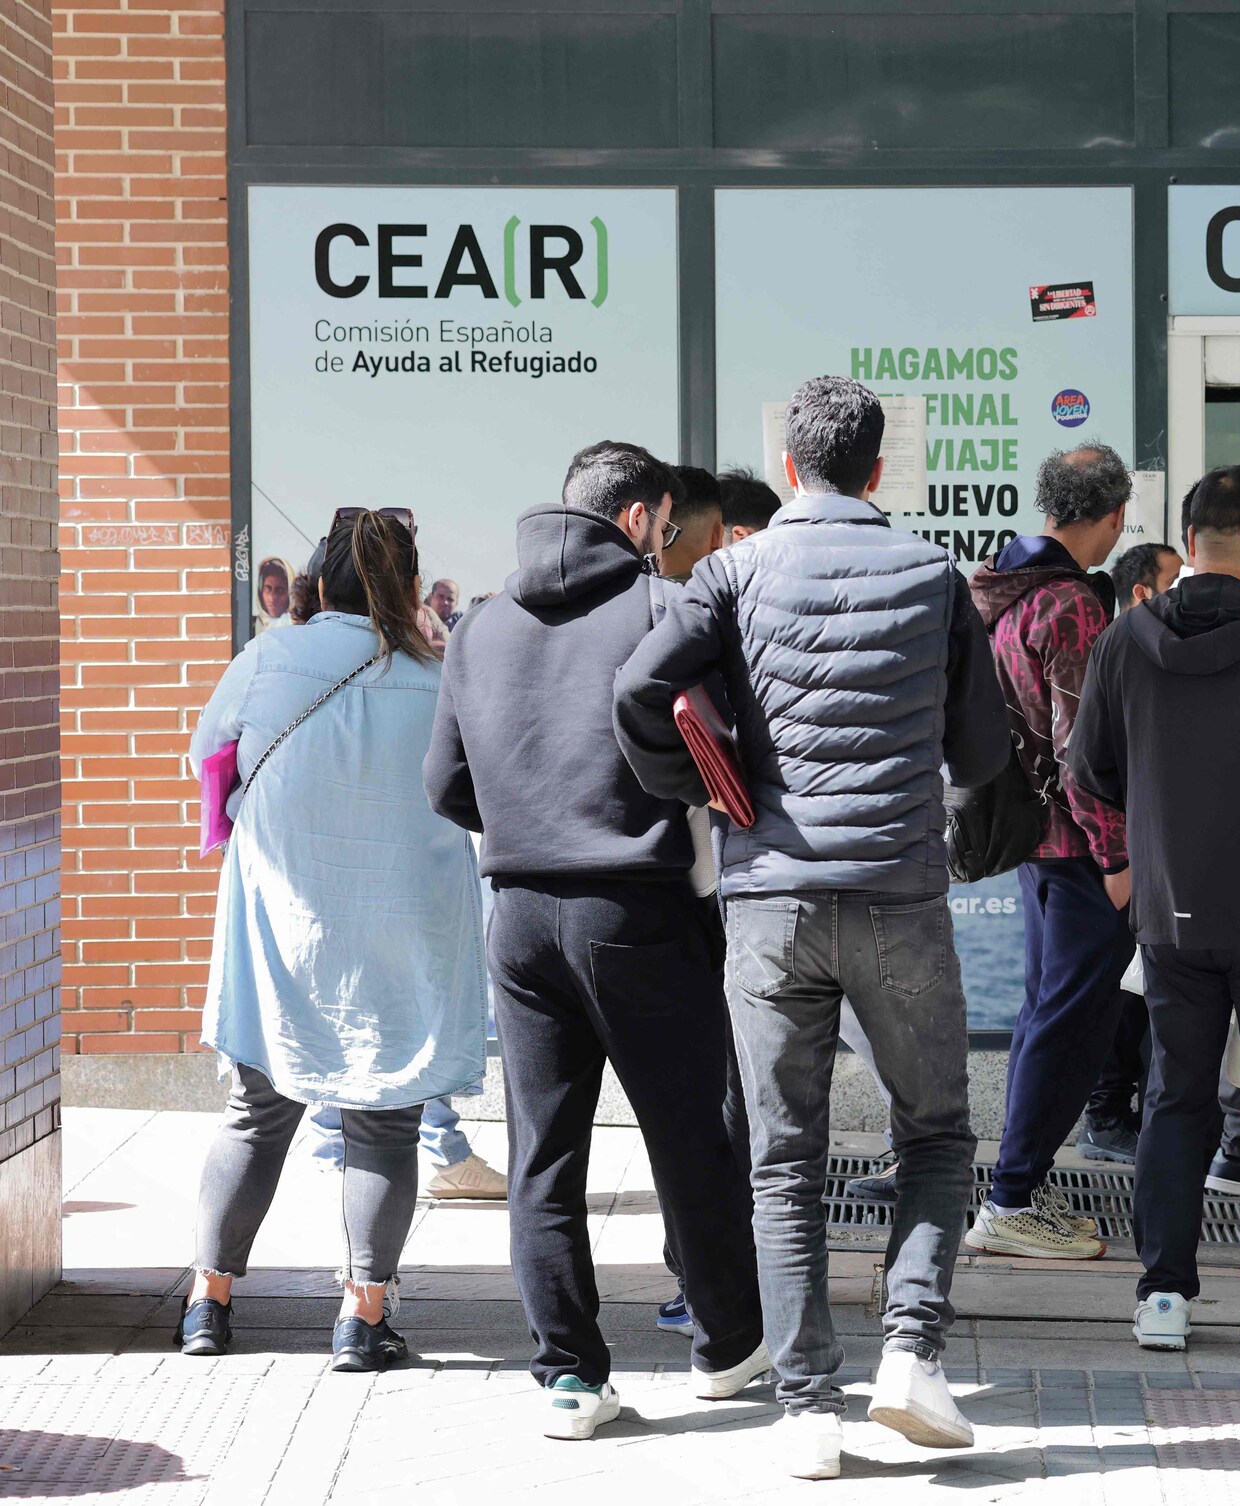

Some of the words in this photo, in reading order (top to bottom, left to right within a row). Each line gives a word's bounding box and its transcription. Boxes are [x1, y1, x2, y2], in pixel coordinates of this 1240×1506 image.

[314, 215, 609, 309] CEA(R)
[315, 319, 430, 344] Comisión
[439, 319, 553, 349] Española
[315, 351, 344, 373] de
[352, 351, 431, 379] Ayuda
[439, 351, 463, 373] al
[471, 351, 598, 379] Refugiado
[850, 347, 1018, 381] HAGAMOS
[922, 393, 1018, 426] FINAL
[1056, 413, 1088, 421] Podemos
[926, 439, 1018, 472] VIAJE
[904, 484, 1018, 517] UEVO
[948, 896, 1017, 915] ar.es
